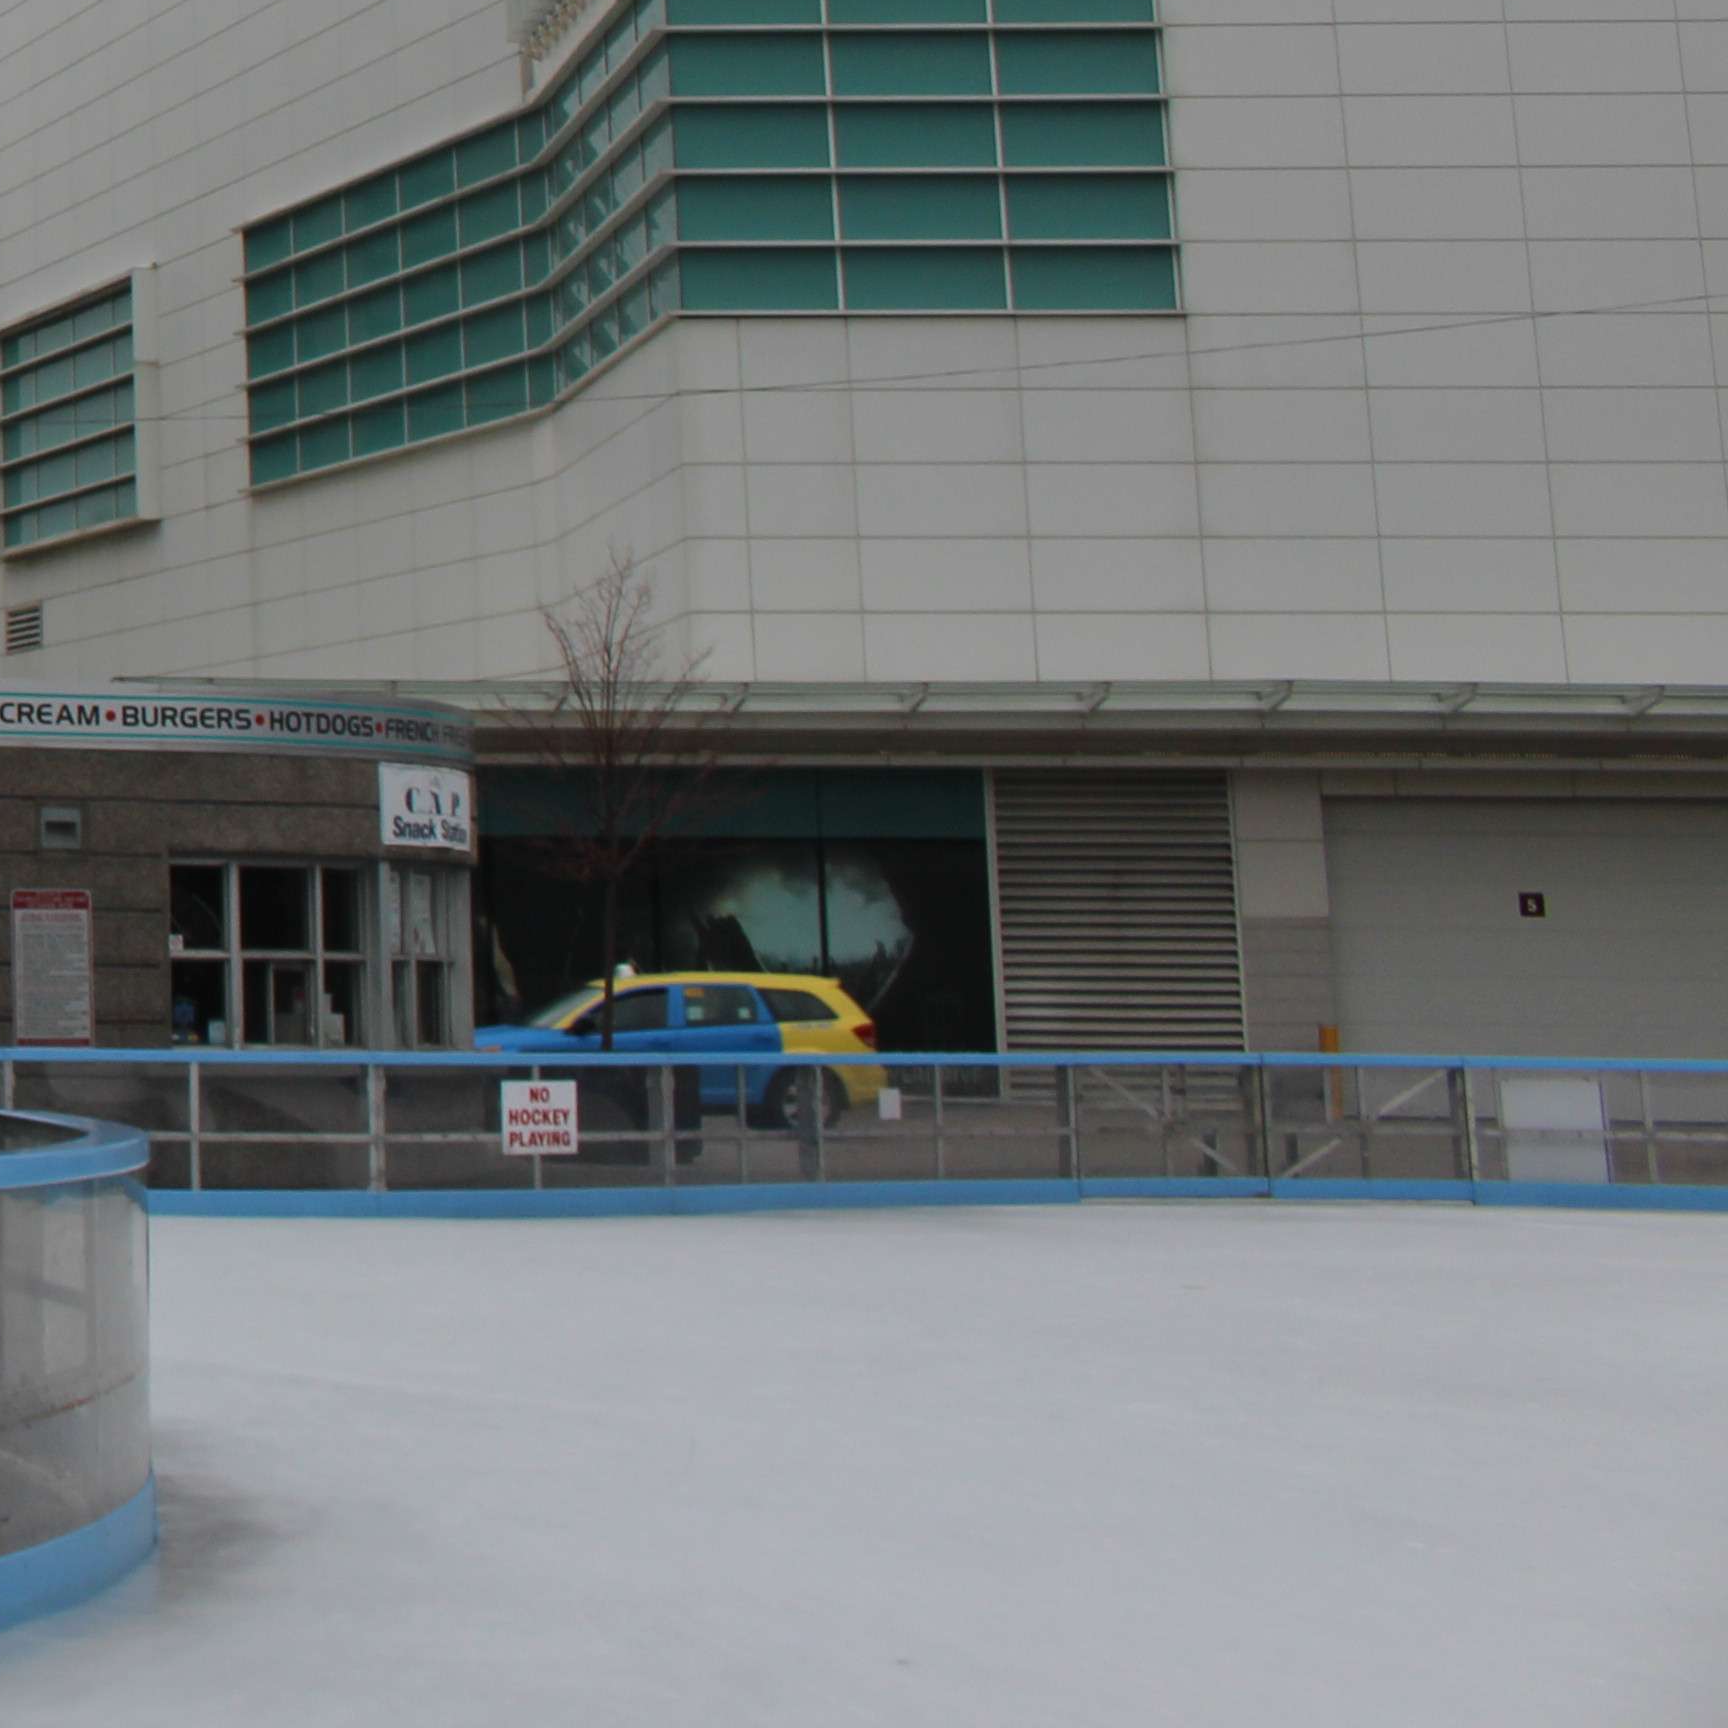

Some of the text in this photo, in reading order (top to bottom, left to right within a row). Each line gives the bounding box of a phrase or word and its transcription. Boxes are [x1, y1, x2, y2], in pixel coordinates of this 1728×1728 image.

[121, 705, 253, 731] BURGERS
[268, 711, 374, 739] HOTDOGS
[385, 718, 440, 743] FRENCH
[393, 815, 438, 840] Snack
[529, 1086, 551, 1102] NO
[508, 1108, 571, 1126] HOCKEY
[509, 1131, 571, 1148] PLAYING
